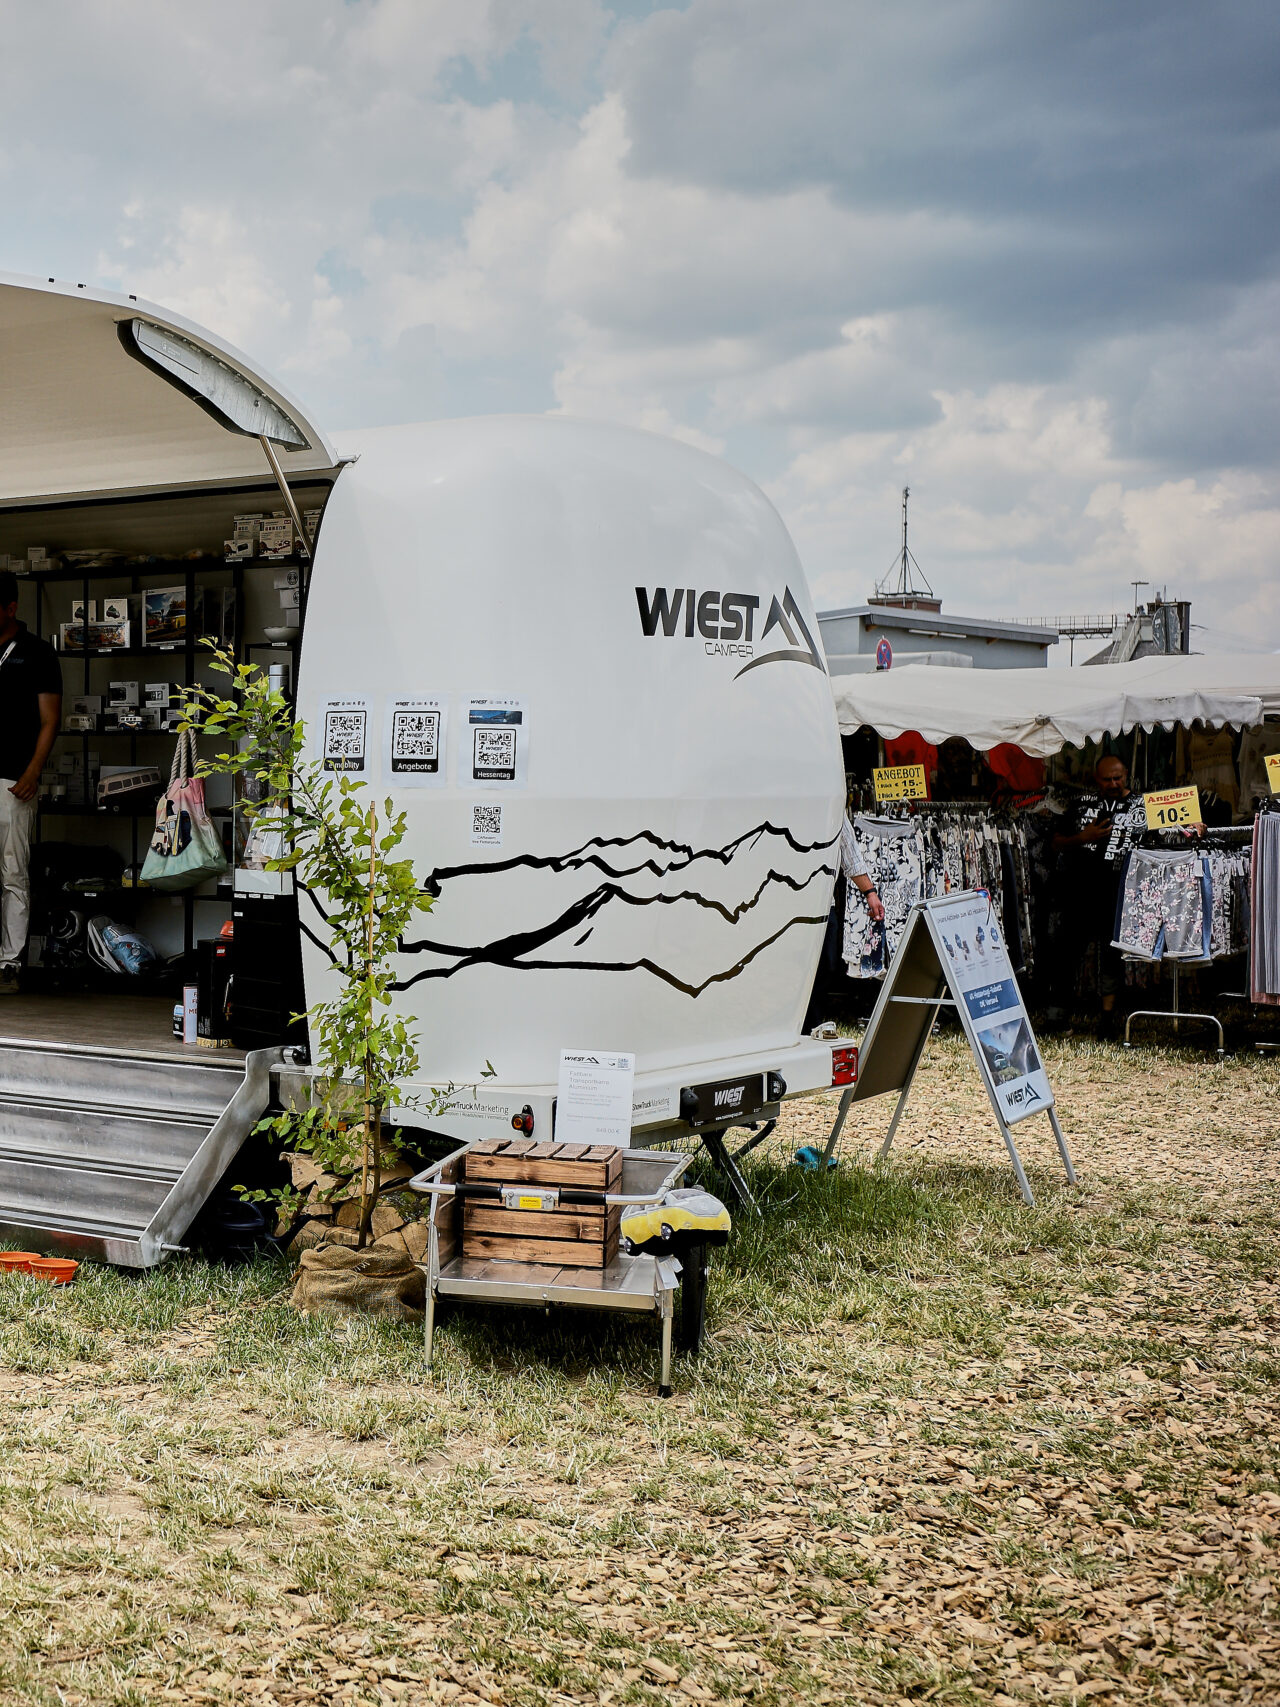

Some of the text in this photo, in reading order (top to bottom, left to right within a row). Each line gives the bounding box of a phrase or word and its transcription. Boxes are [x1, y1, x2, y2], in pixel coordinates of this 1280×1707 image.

[635, 586, 759, 642] WIEST
[704, 642, 754, 658] CAMPER
[397, 762, 432, 771] Angebote
[477, 771, 511, 779] Hessentag
[877, 767, 921, 781] ANGEBOT
[1147, 790, 1195, 803] Angebot
[568, 1084, 598, 1092] Aluminium
[714, 1085, 745, 1106] WIEST
[1005, 1087, 1025, 1107] WIEST
